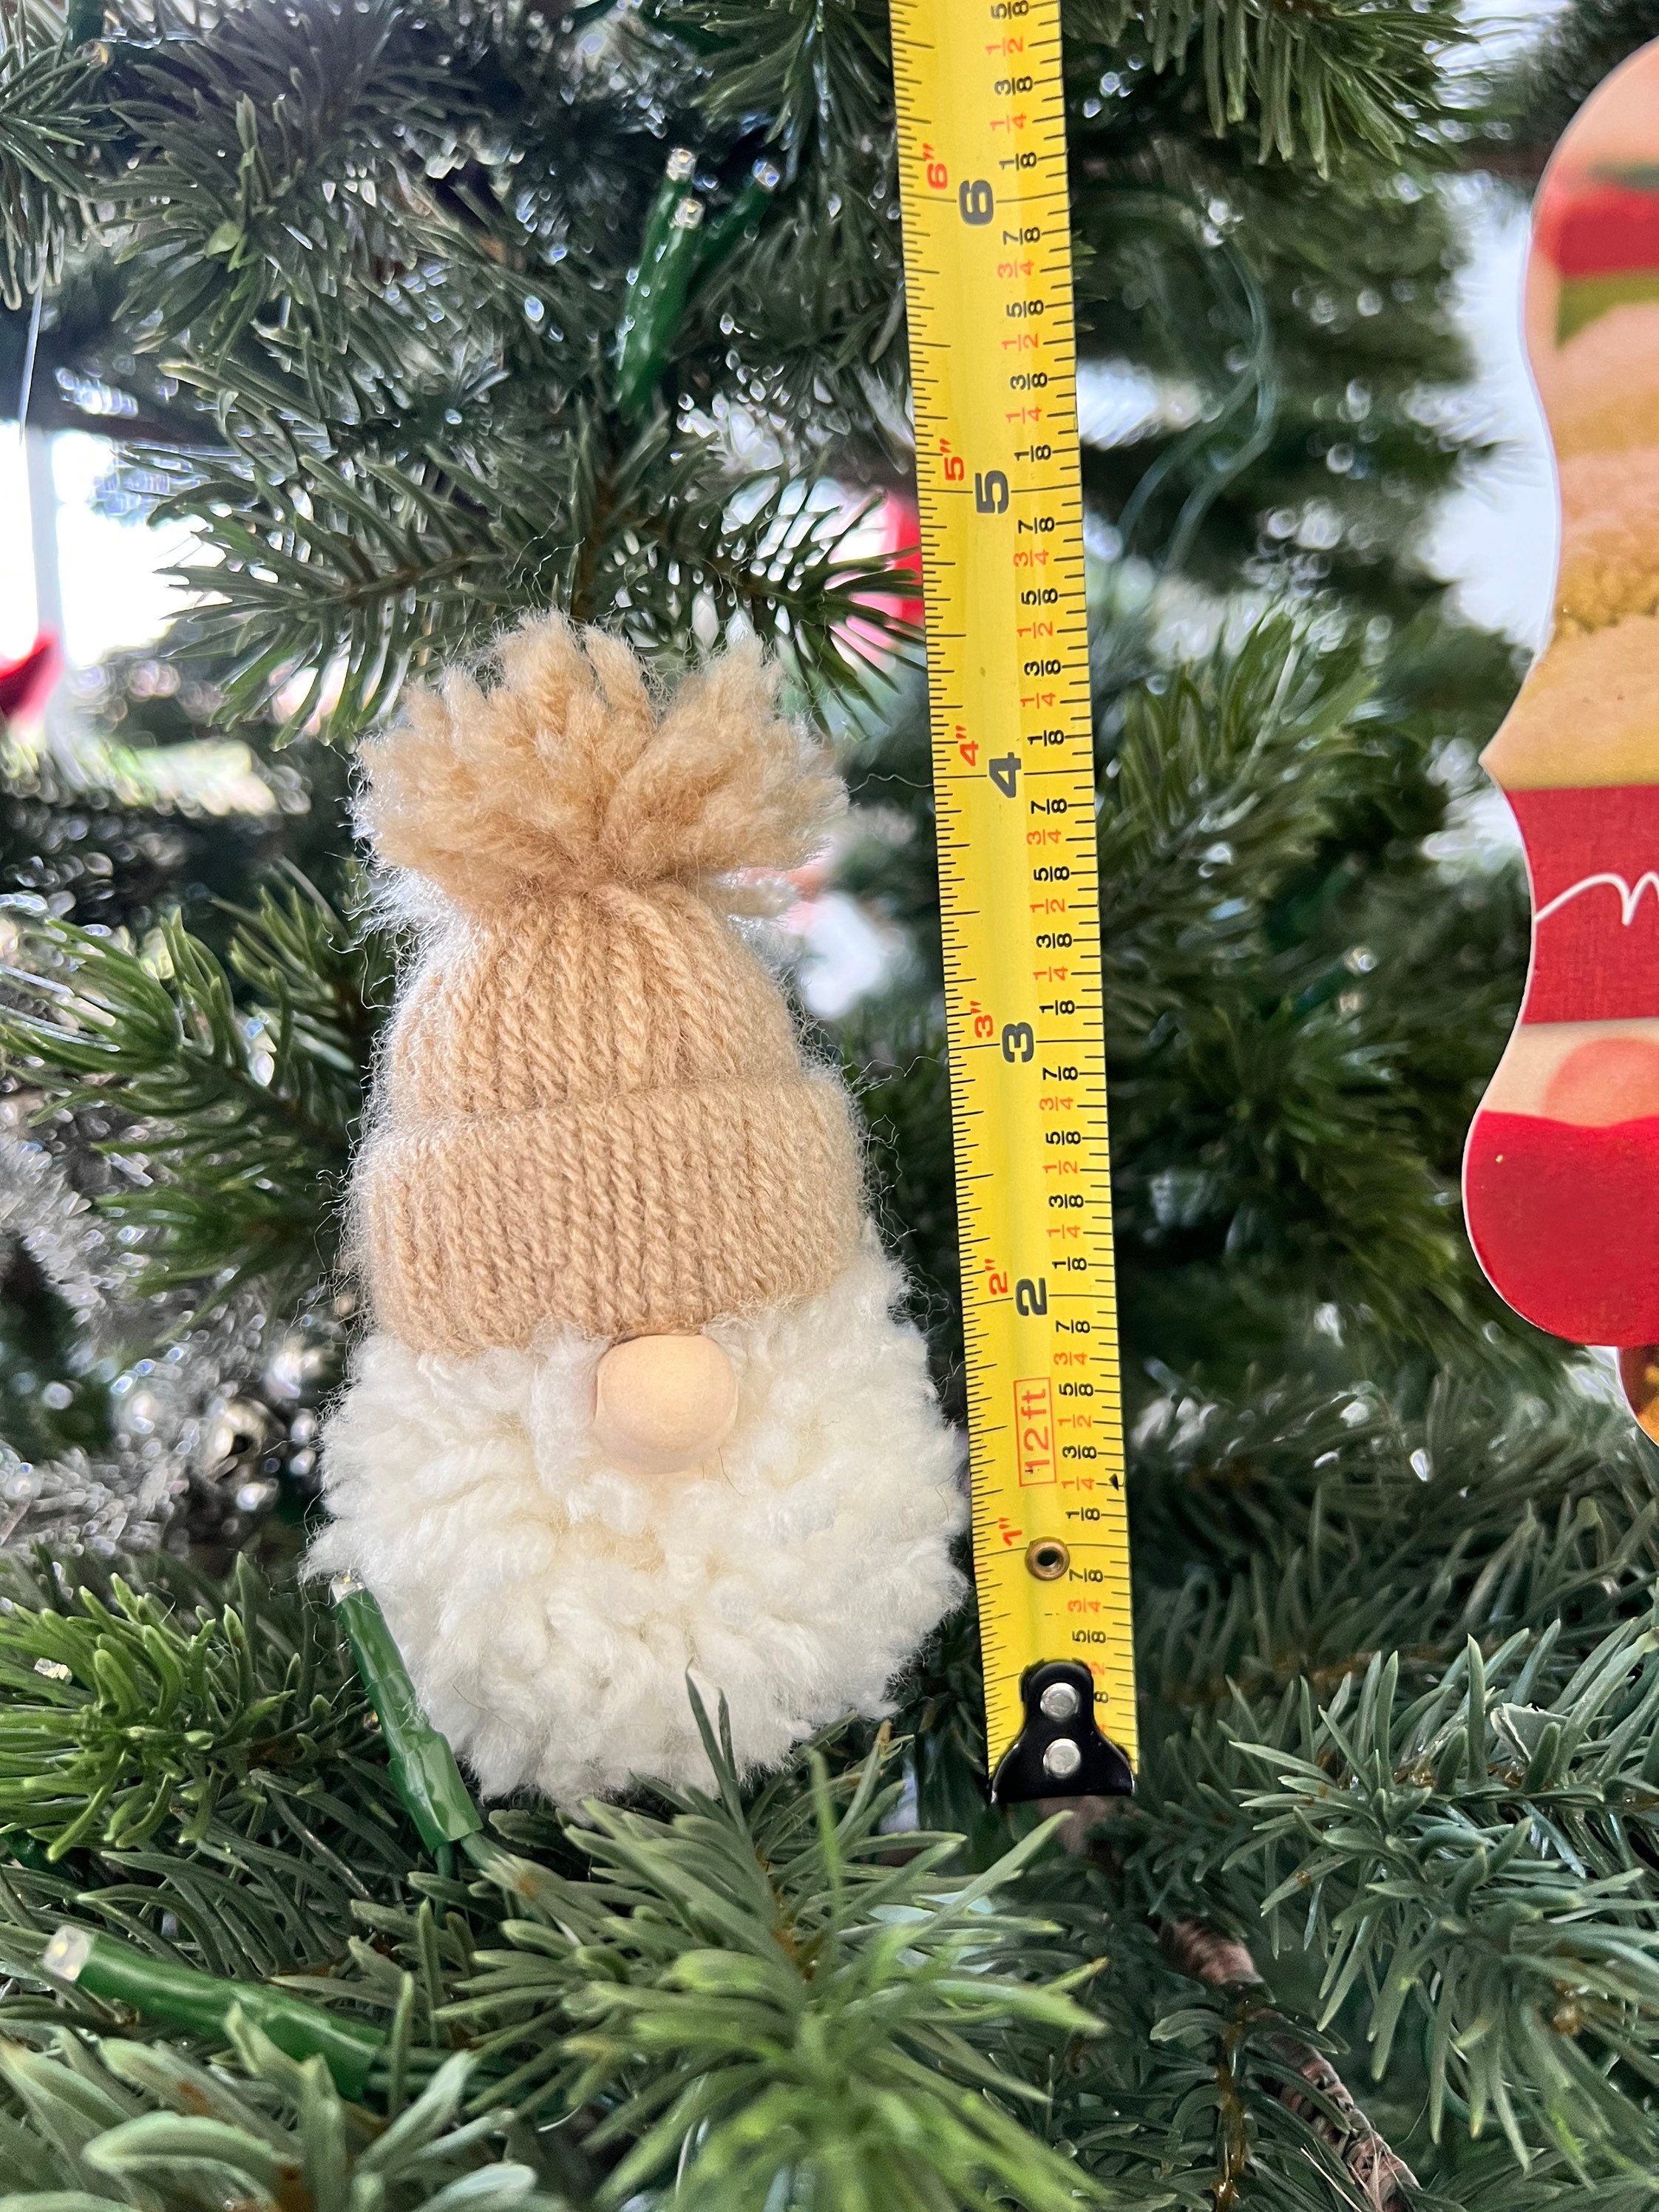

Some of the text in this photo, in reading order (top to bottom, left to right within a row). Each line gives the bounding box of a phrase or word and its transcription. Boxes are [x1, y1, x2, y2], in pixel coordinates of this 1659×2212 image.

[959, 180, 994, 226] 6
[975, 470, 1009, 514] 5
[988, 752, 1021, 798] 4
[1002, 1022, 1034, 1063] 3
[1015, 1278, 1048, 1317] 2
[1021, 1388, 1051, 1473] 12ft
